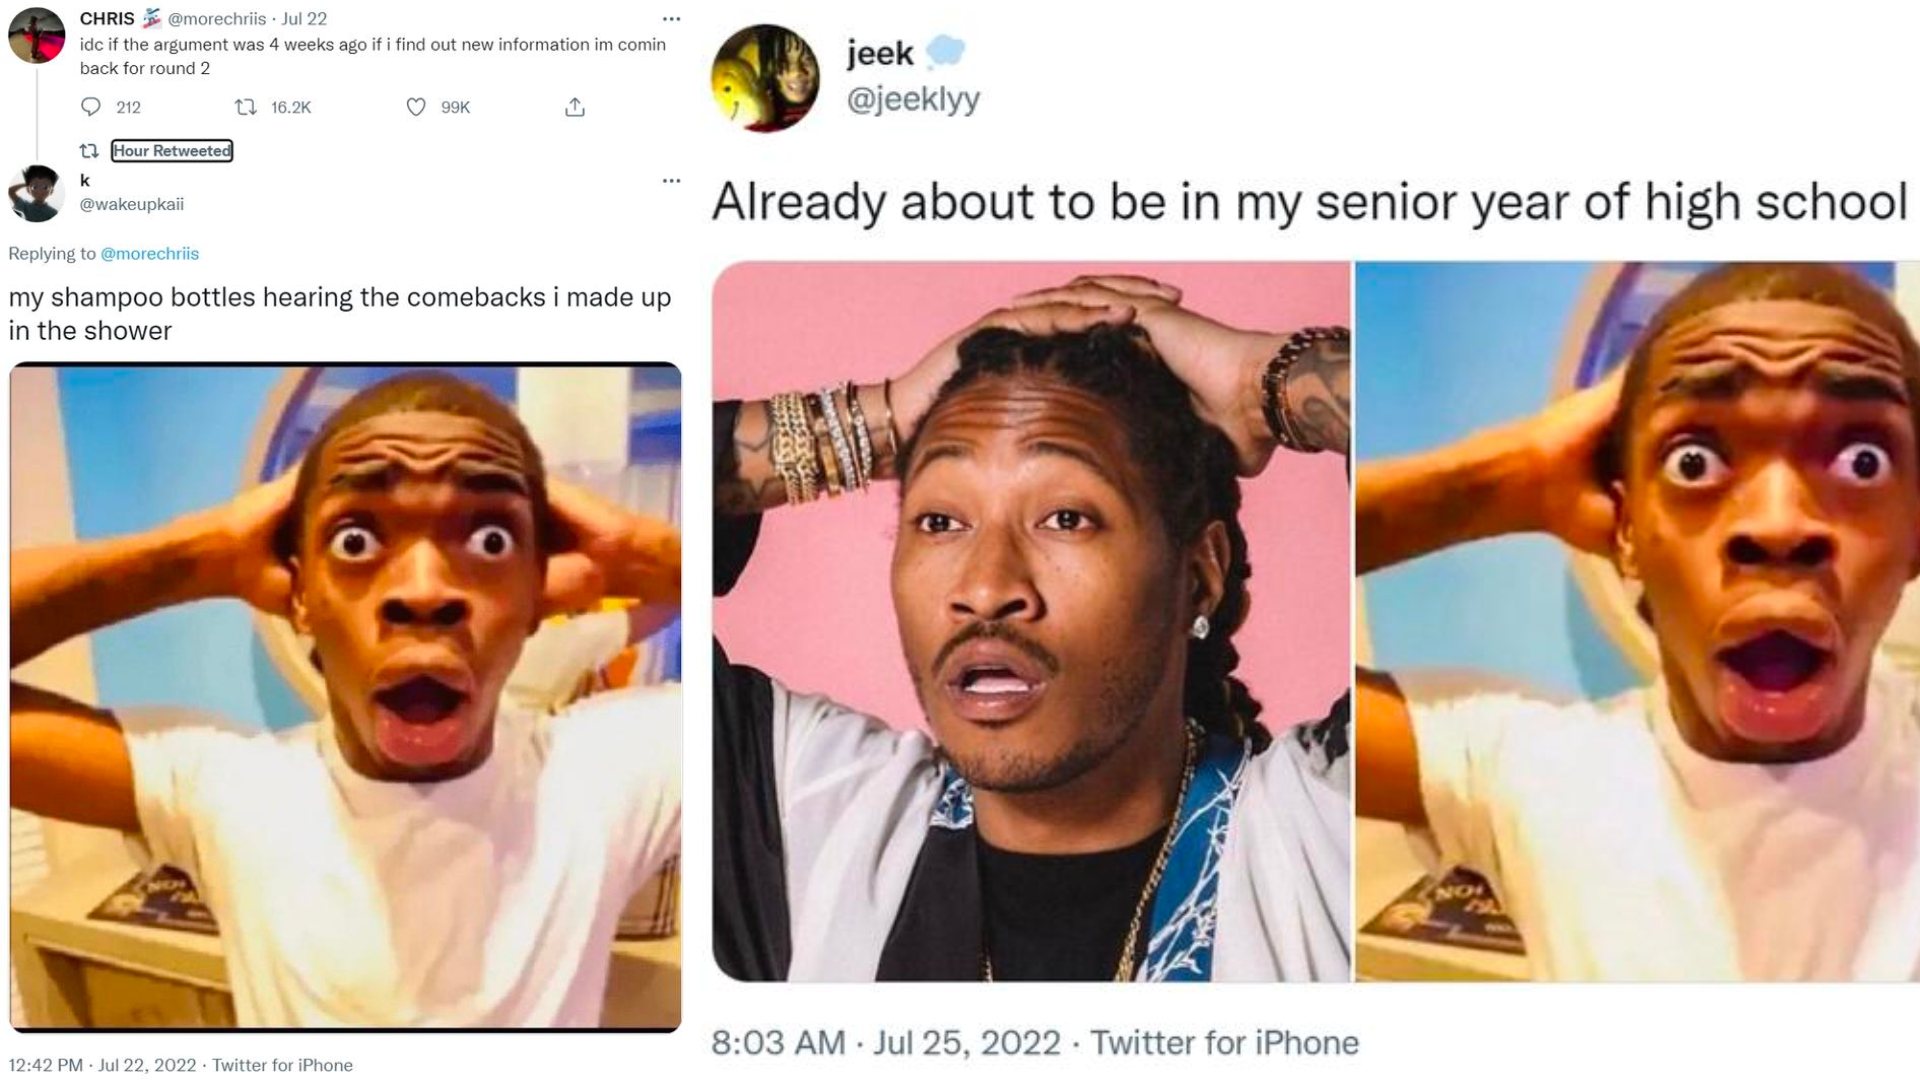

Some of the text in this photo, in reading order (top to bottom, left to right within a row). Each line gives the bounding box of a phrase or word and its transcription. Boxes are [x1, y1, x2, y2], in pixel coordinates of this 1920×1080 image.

[79, 11, 327, 28] CHRIS @morechriis Jul 22
[80, 36, 666, 55] idc if the argument was 4 weeks ago if i find out new information im comin
[845, 37, 915, 72] jeek
[80, 60, 211, 75] back for round 2
[116, 100, 141, 114] 212
[271, 100, 312, 114] 16.2K
[441, 100, 471, 114] 99K
[847, 84, 981, 118] @jeeklyy
[113, 143, 232, 158] Hour Retweeted
[80, 172, 91, 188] k
[79, 197, 184, 215] @wakeupkaii
[711, 179, 1907, 231] Already about to be in my senior year of high school
[8, 246, 200, 264] Replying to @morechriis
[9, 285, 672, 313] my shampoo bottles hearing the comebacks i made up
[9, 318, 173, 341] in the shower
[711, 1028, 1360, 1060] 8:03 AM Jul 25, 2022 Twitter for iPhone
[8, 1058, 353, 1074] 12:42 PM Jul 22, 2022 Twitter for iPhone
